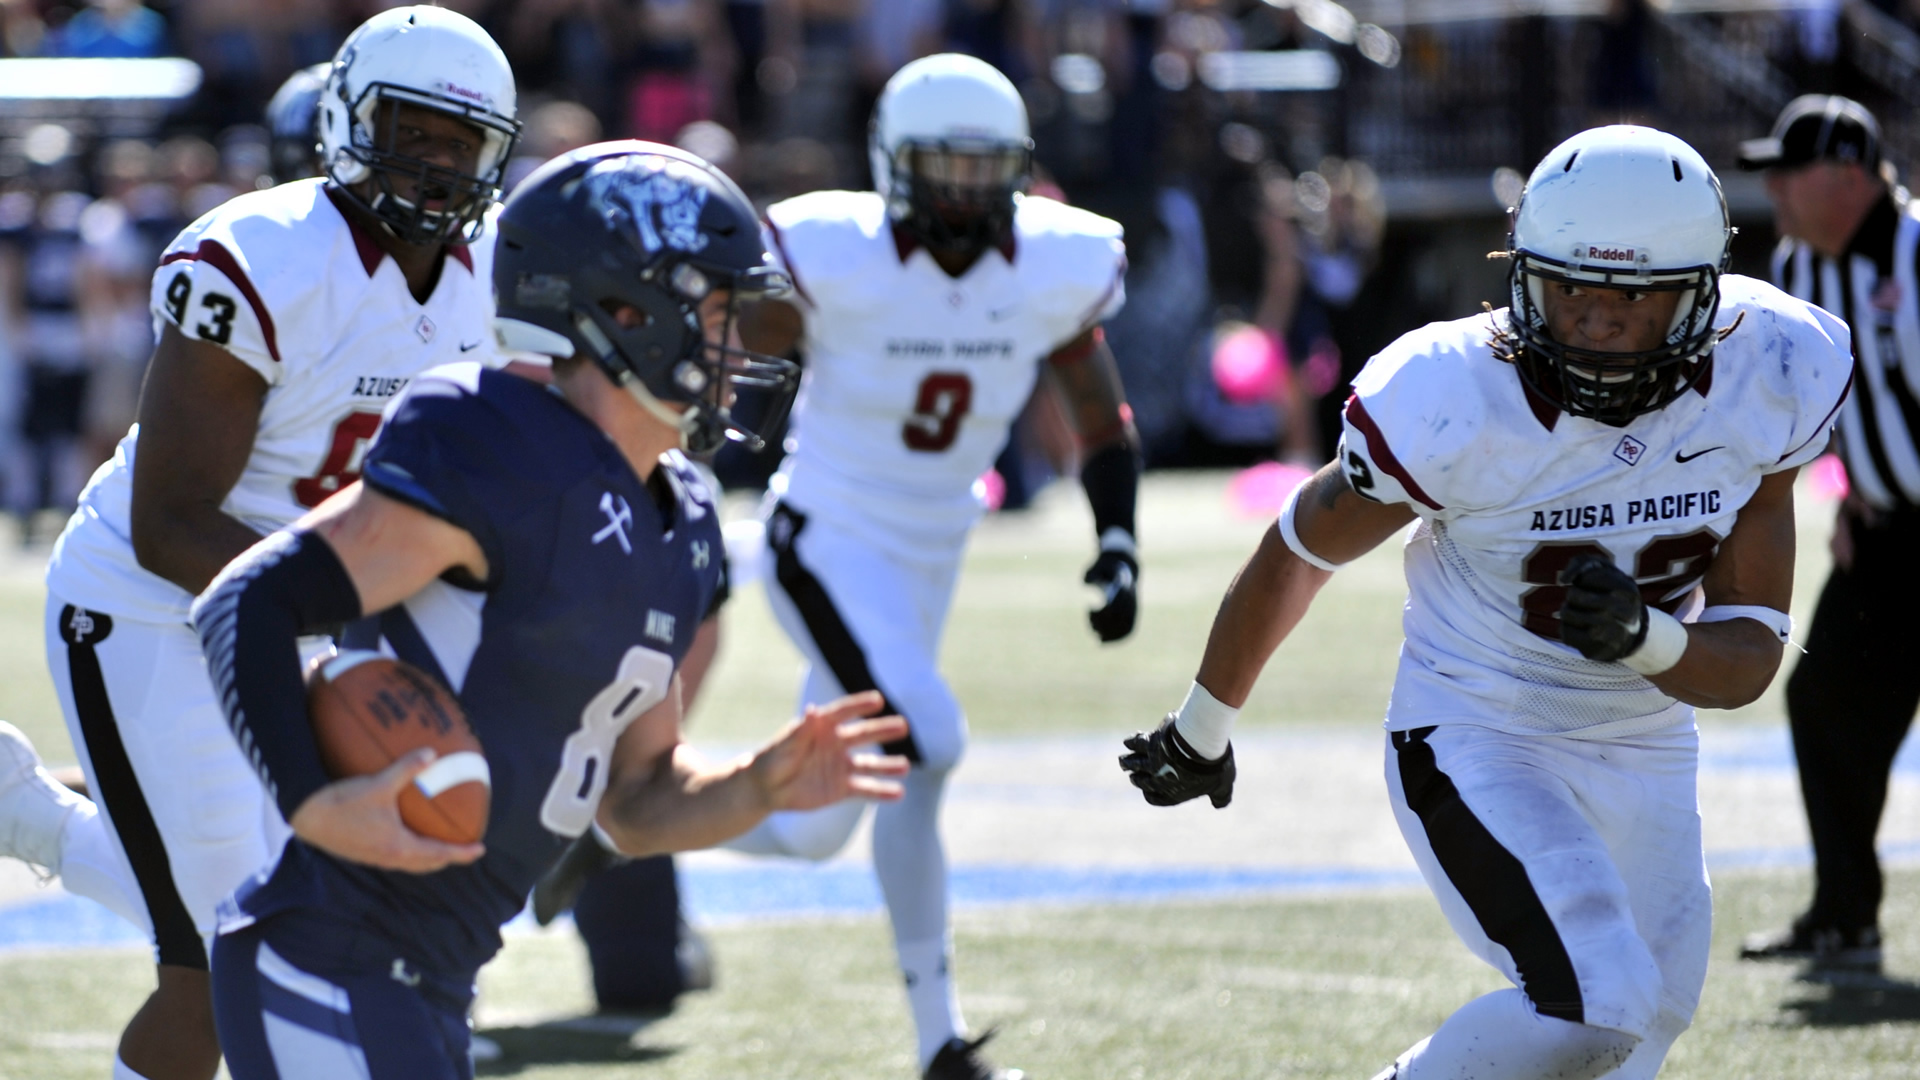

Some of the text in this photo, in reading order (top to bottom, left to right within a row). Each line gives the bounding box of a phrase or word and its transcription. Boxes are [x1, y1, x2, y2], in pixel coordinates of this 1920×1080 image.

[1588, 246, 1635, 261] Riddell
[165, 271, 236, 344] 93
[902, 370, 973, 452] 9
[1530, 489, 1721, 531] AZUSA PACIFIC
[540, 645, 674, 838] 8
